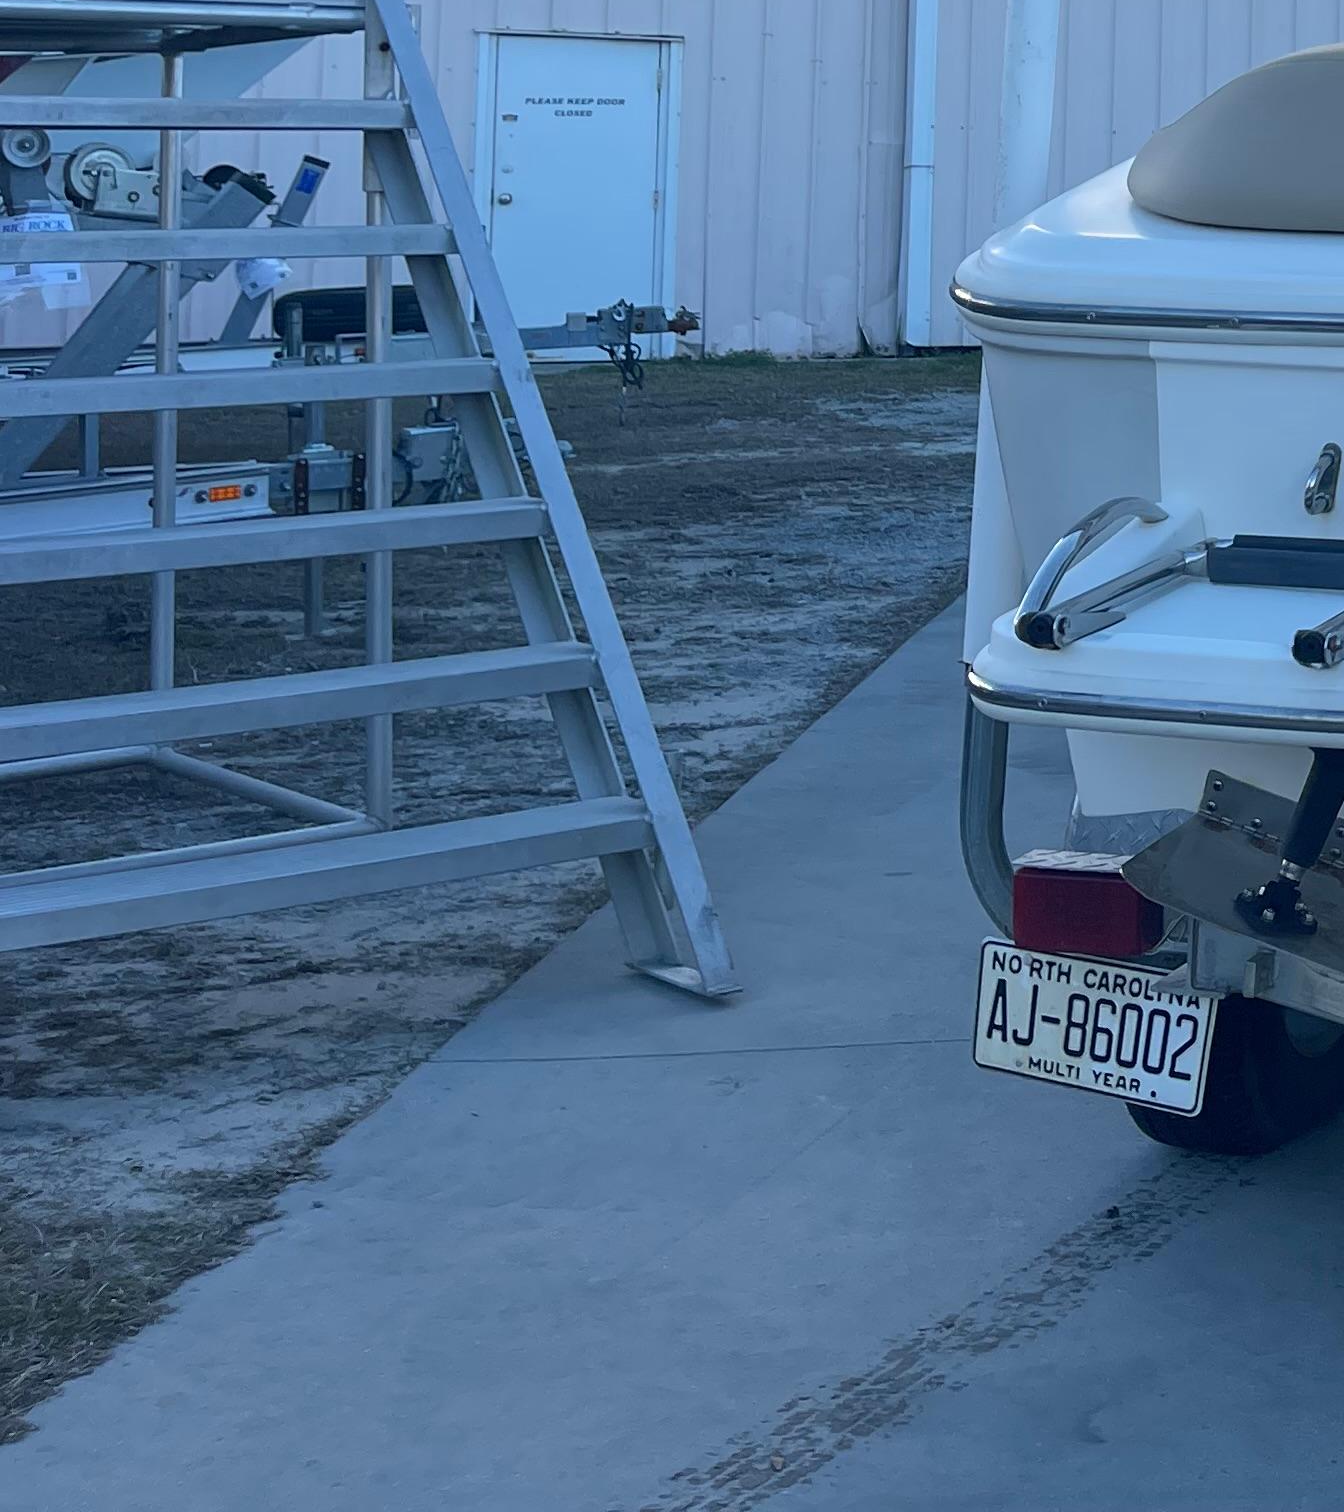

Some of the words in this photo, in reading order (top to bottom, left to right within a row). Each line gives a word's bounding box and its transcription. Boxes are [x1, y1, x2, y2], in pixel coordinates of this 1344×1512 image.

[524, 97, 564, 106] PLEASE
[567, 97, 594, 106] KEEP
[596, 98, 626, 106] DOOR
[554, 109, 593, 118] CLOSED
[991, 950, 1073, 985] NORTH
[986, 977, 1199, 1082] AJ-86002
[1028, 1056, 1081, 1080] MULTI
[1092, 1069, 1141, 1094] YEAR
